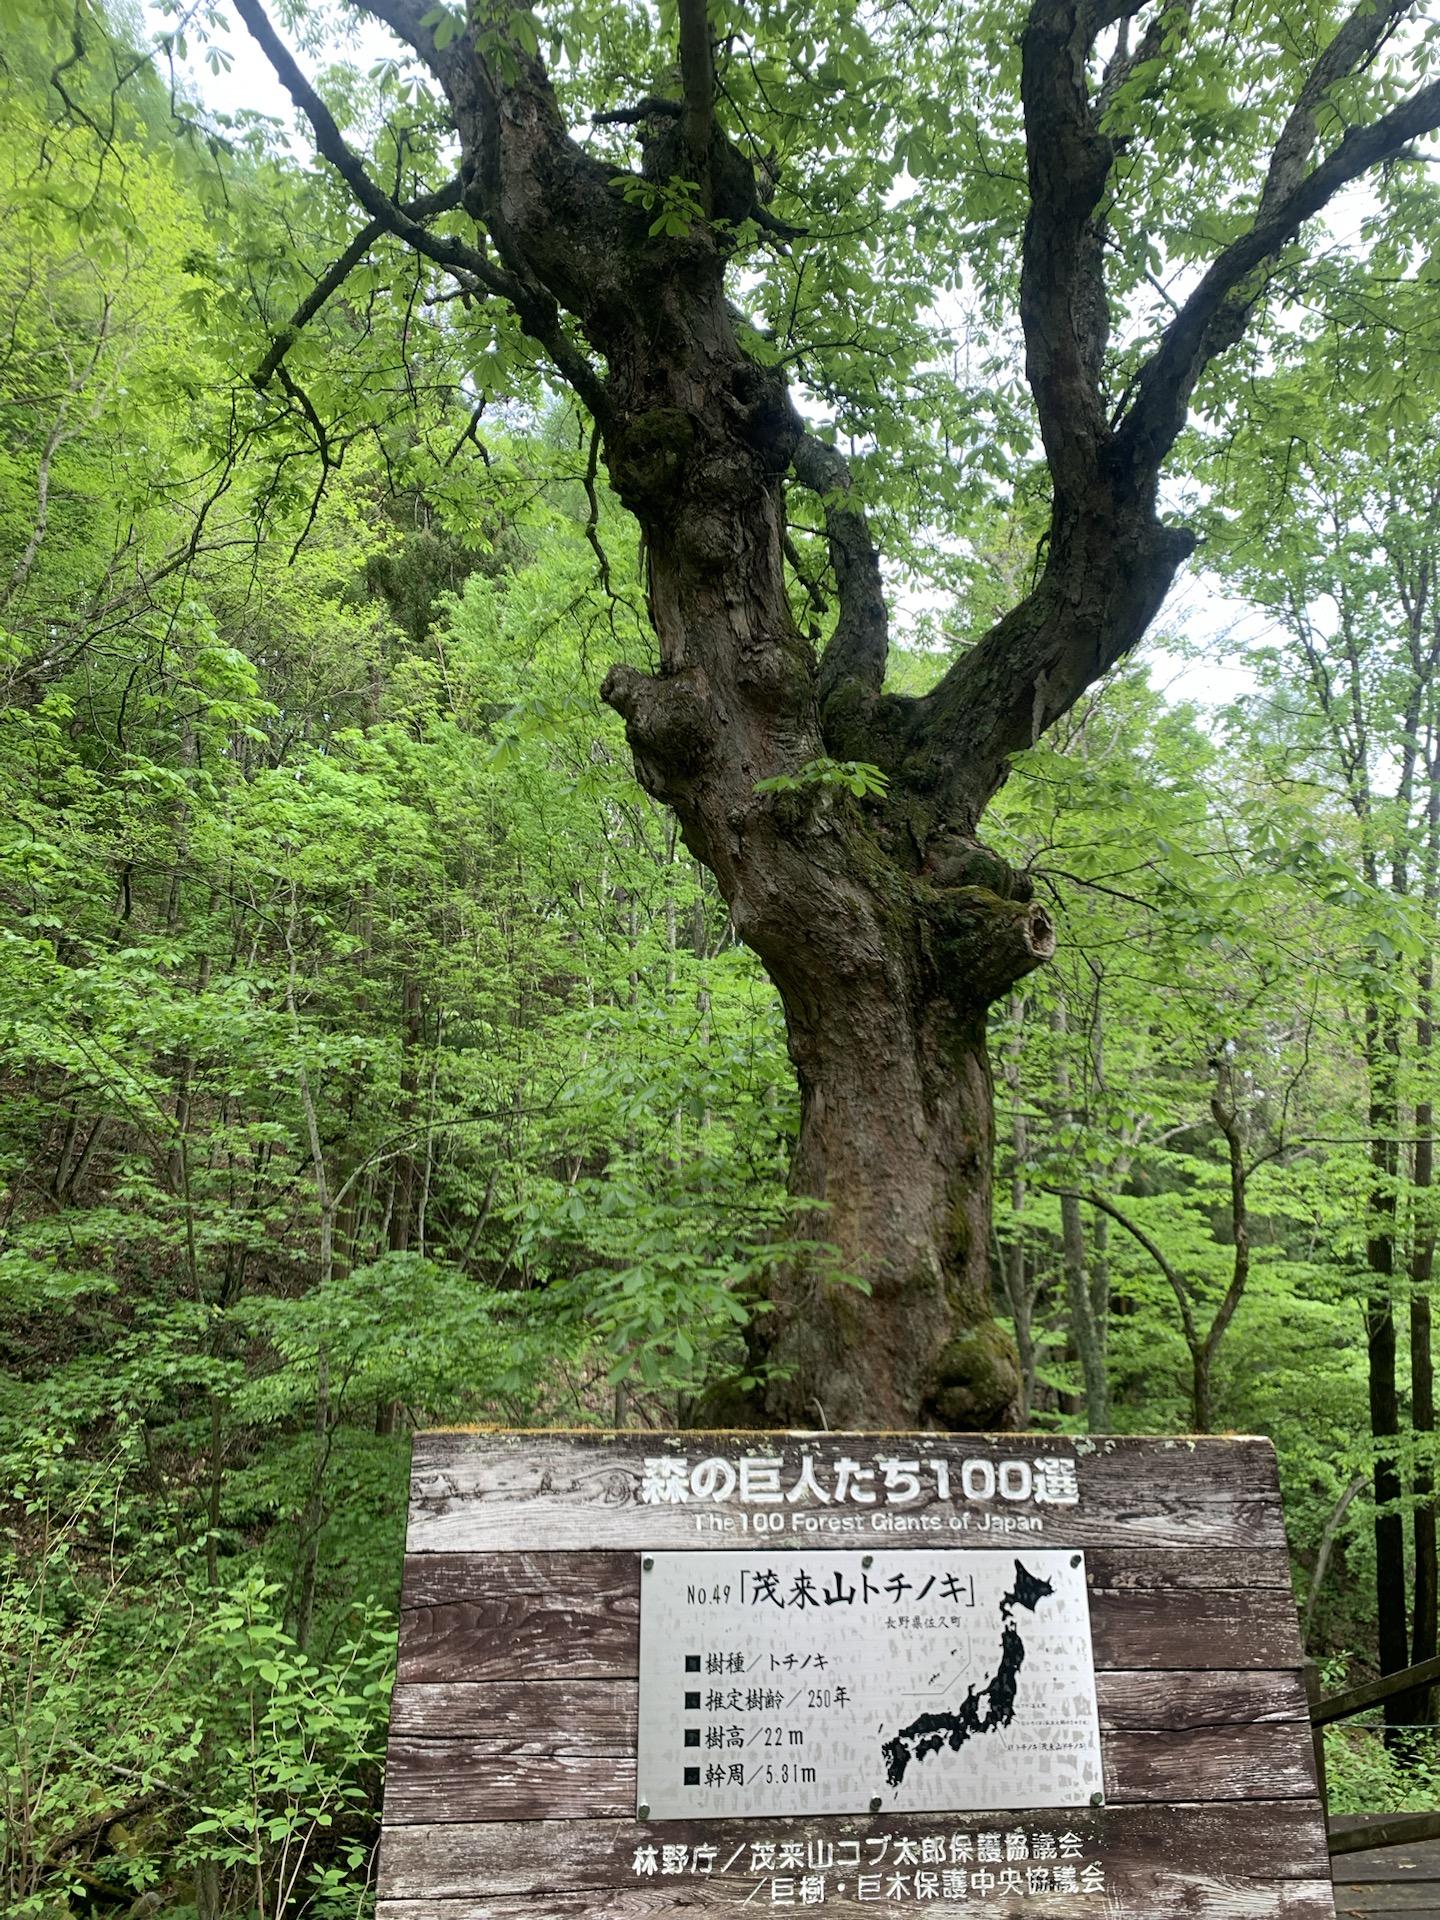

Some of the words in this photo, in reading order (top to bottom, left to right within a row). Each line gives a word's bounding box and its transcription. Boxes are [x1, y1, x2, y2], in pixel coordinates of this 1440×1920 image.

[641, 1456, 1080, 1504] 森の巨人たち100選
[694, 1513, 735, 1531] The
[739, 1512, 784, 1532] 100
[791, 1513, 864, 1531] Forest
[871, 1512, 942, 1531] Giants
[949, 1512, 971, 1530] of
[976, 1512, 1043, 1532] Japan
[687, 1583, 731, 1605] No.49
